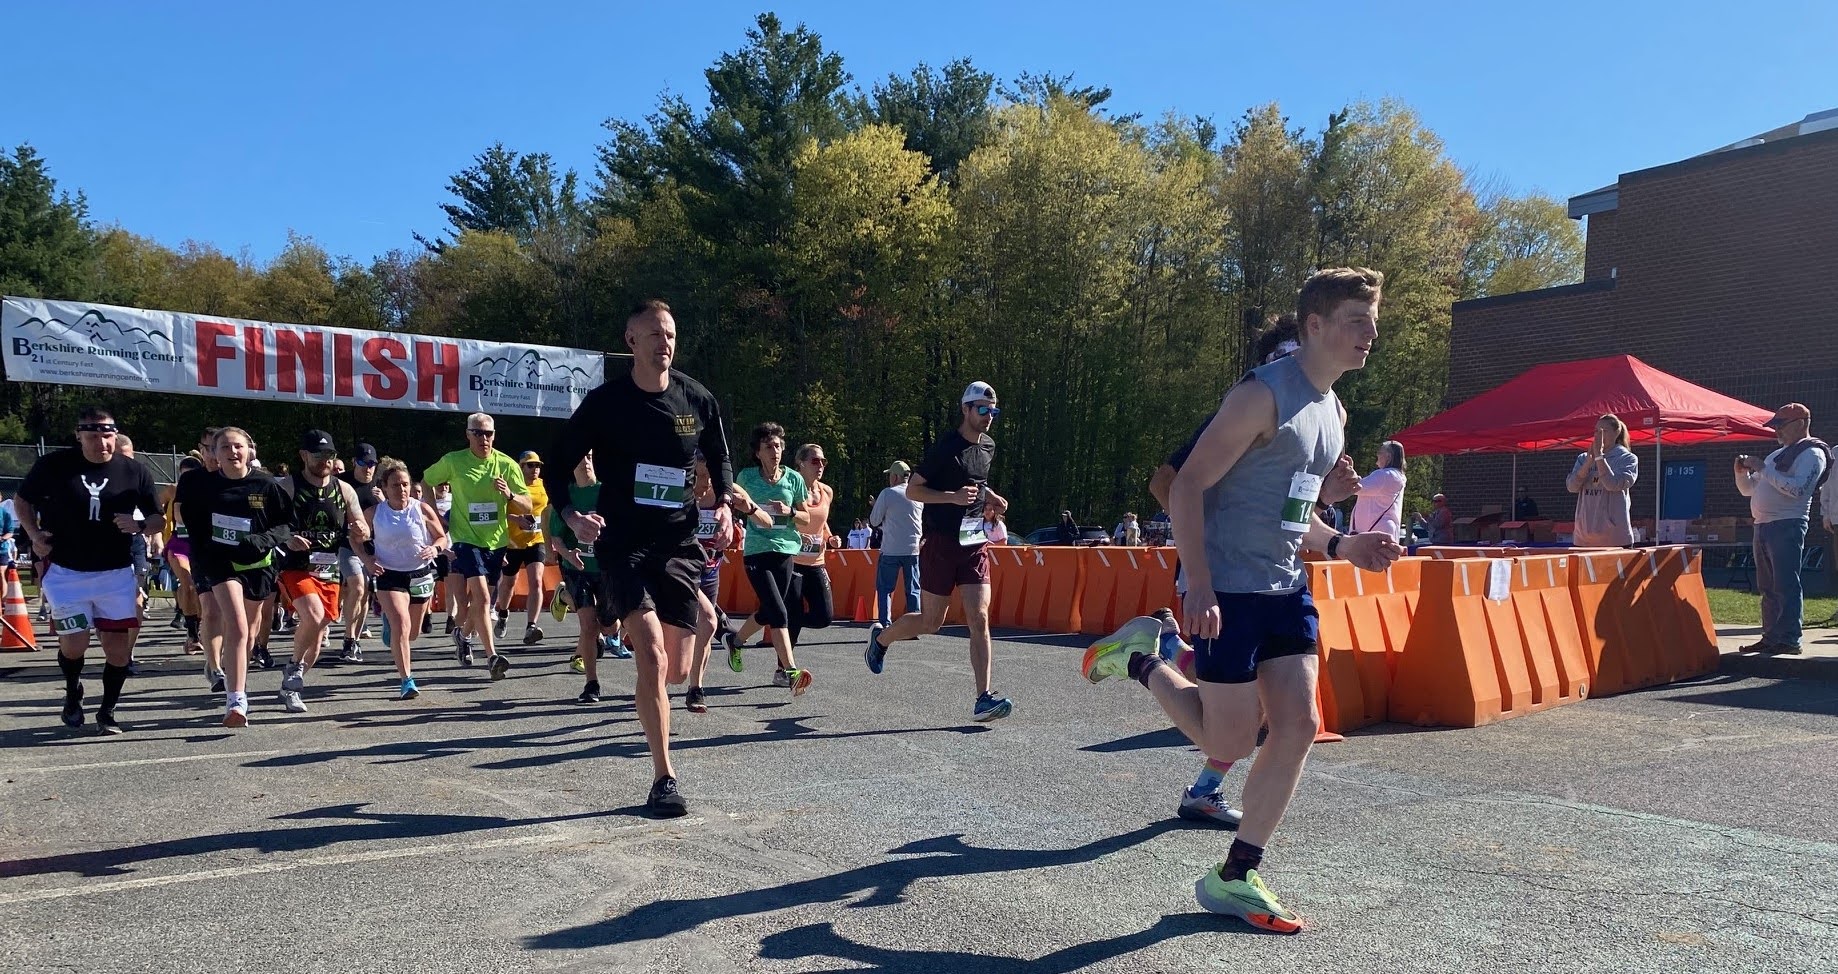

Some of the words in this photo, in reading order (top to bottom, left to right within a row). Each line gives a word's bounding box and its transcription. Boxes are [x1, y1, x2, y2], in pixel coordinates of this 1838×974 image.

[12, 337, 84, 356] Berkshire
[87, 345, 139, 360] Running
[142, 350, 184, 363] Center
[53, 359, 79, 368] Century
[195, 321, 460, 404] FINISH
[39, 368, 160, 383] www.berkshirerunningcenter.com
[469, 374, 524, 391] Berkshire
[526, 381, 565, 393] Running
[566, 385, 592, 395] Cente
[651, 484, 669, 500] 17
[478, 512, 490, 521] 58
[1299, 501, 1313, 523] 14
[222, 529, 236, 541] 83
[698, 523, 717, 534] 237
[314, 564, 331, 573] 232
[419, 584, 430, 594] 13
[61, 617, 77, 630] 10
